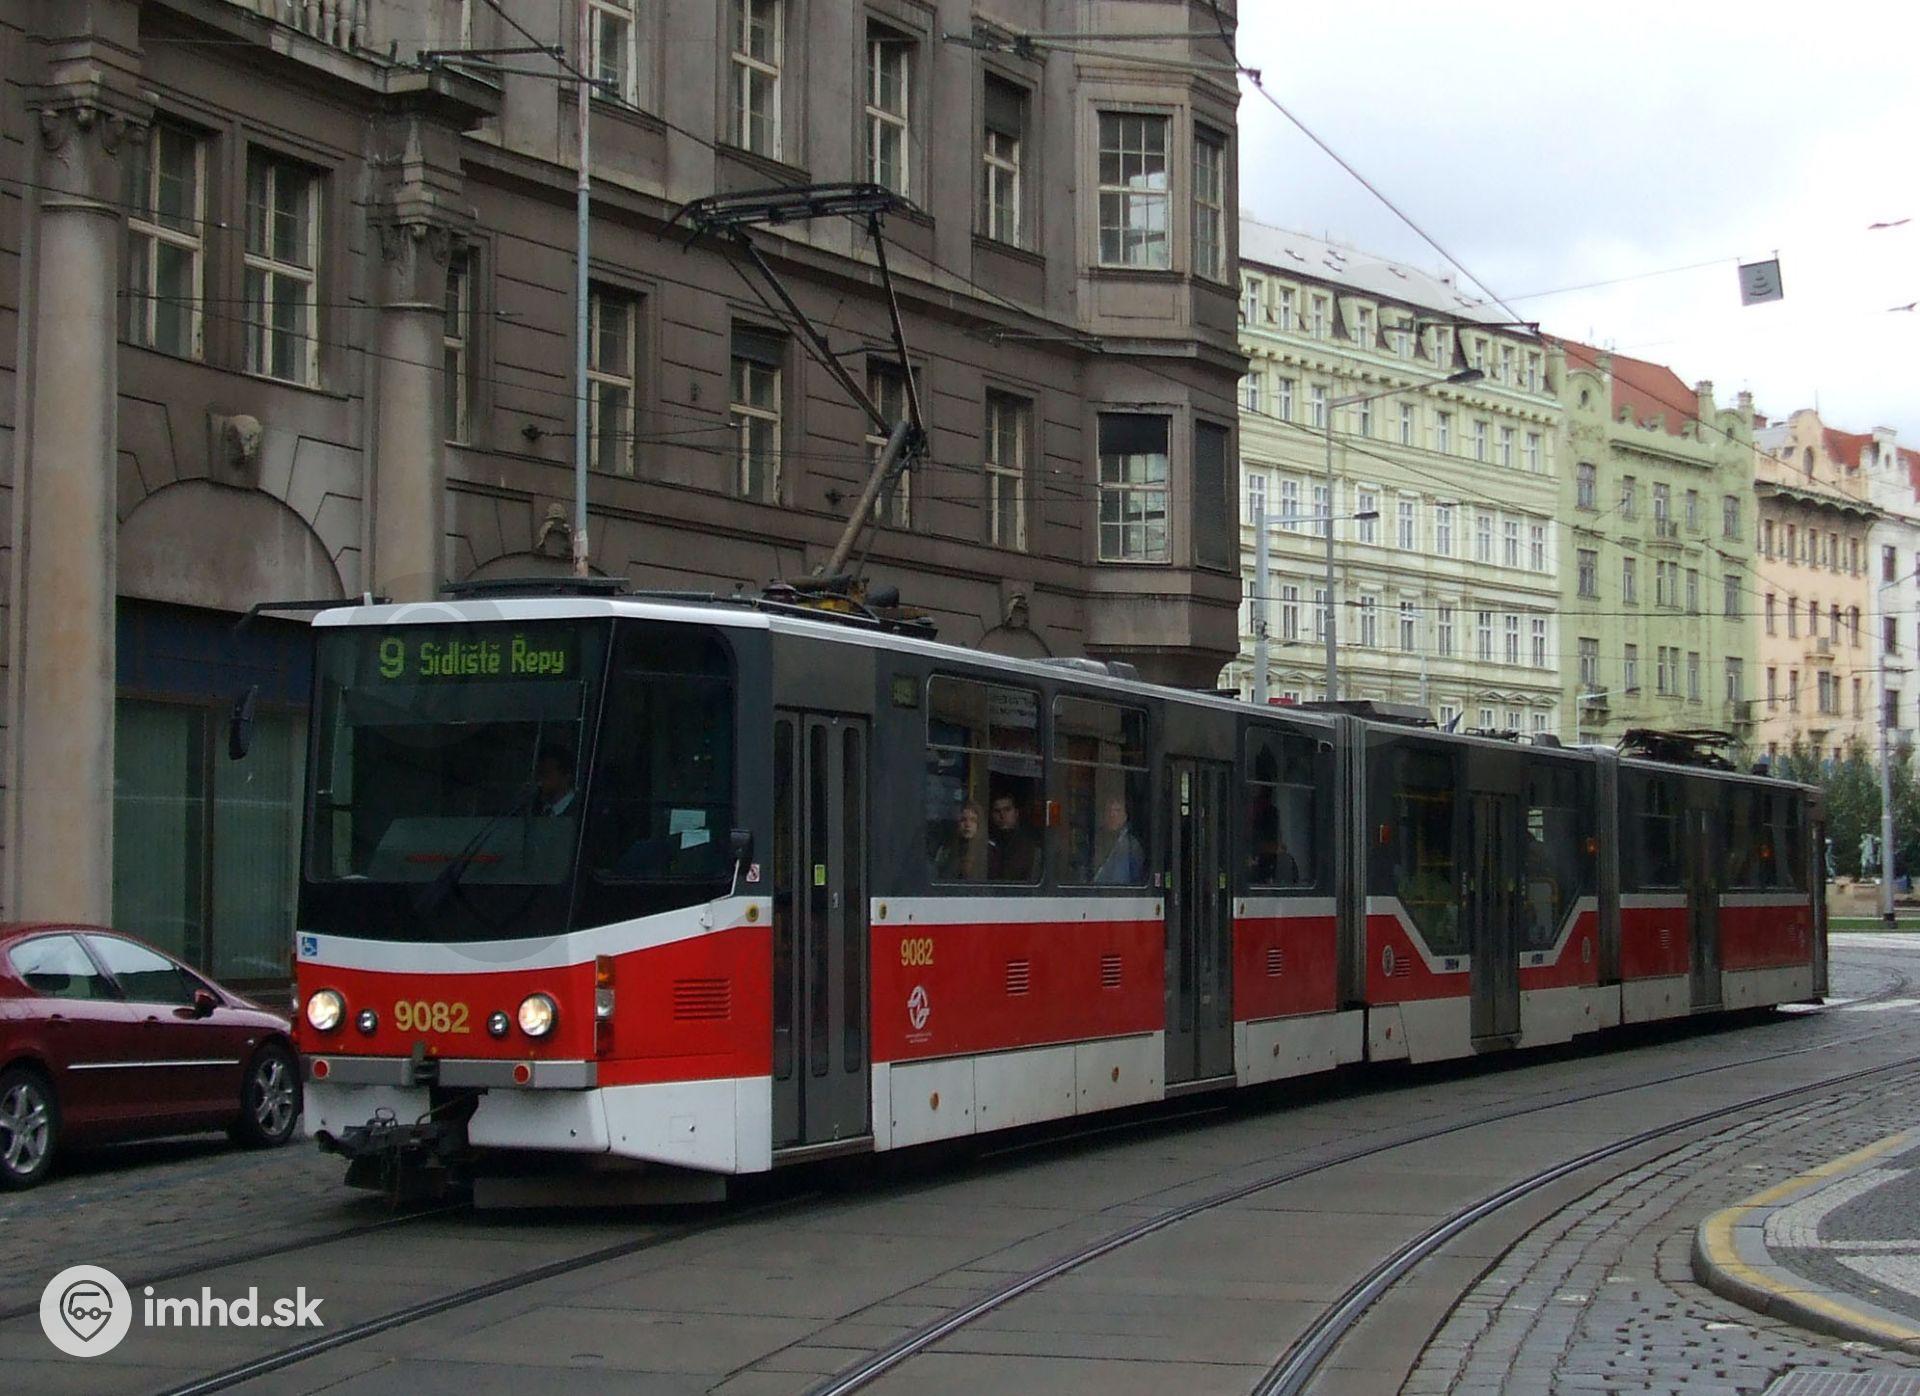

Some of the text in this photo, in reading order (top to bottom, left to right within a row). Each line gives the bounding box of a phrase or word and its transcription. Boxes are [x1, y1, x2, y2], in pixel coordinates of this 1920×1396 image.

[379, 637, 405, 678] 9
[511, 633, 565, 674] Řepy
[901, 939, 934, 966] 9082
[394, 1000, 470, 1034] 9082
